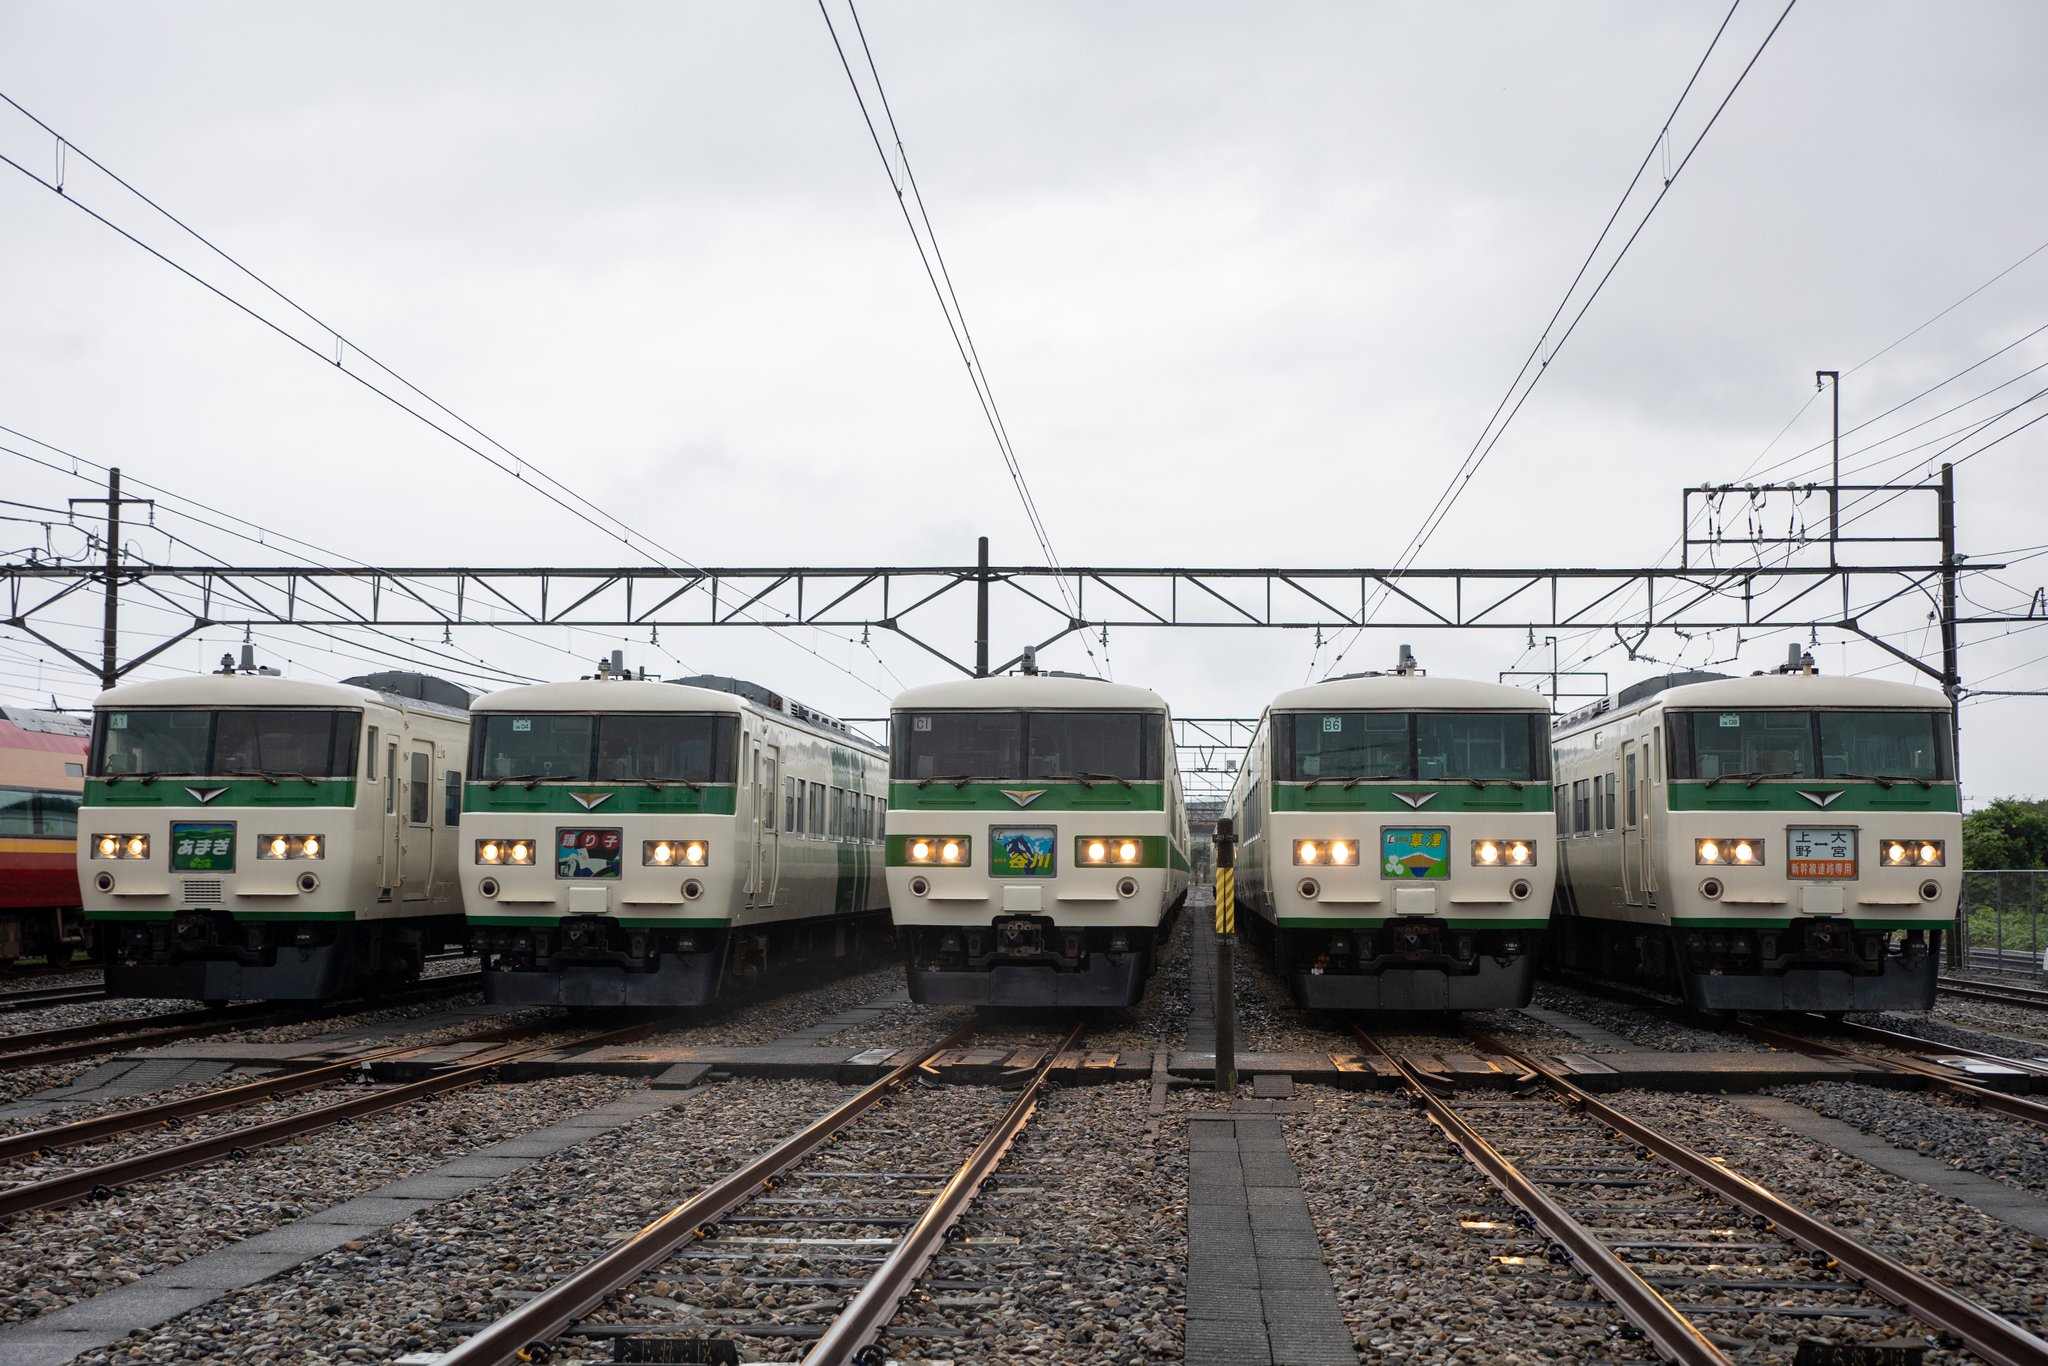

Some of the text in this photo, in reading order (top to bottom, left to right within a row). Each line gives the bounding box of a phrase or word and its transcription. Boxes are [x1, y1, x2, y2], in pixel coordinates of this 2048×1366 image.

[112, 717, 124, 728] A1
[1325, 720, 1340, 731] B6
[177, 838, 230, 855] あまぎ
[562, 834, 617, 848] 踊り子
[1409, 832, 1441, 848] 草津
[1796, 832, 1811, 857] 上野
[1831, 832, 1846, 857] 大宮
[1009, 852, 1050, 868] 谷川
